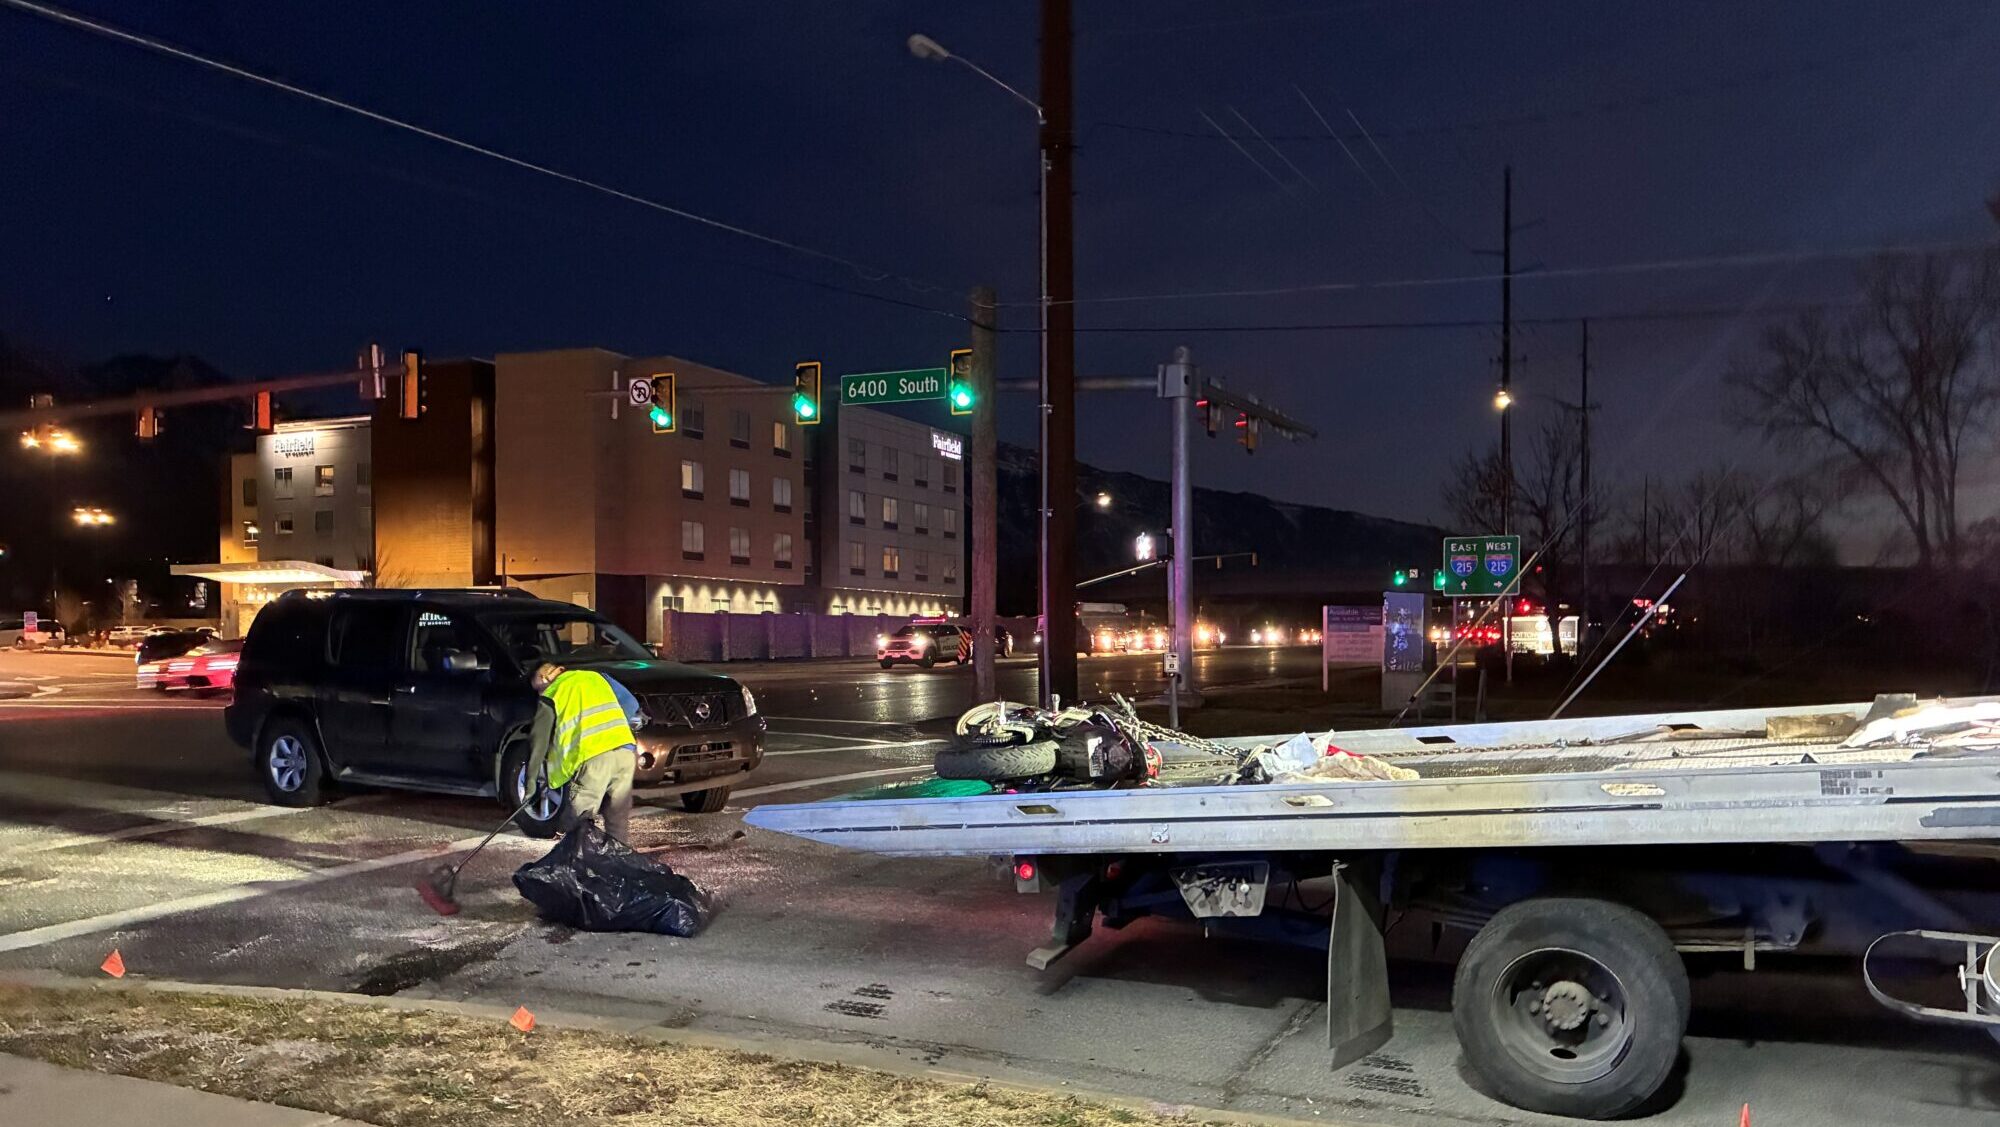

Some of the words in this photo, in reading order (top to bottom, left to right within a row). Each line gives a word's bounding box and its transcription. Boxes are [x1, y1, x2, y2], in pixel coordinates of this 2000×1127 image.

[848, 379, 887, 398] 6400
[898, 376, 938, 394] South
[274, 437, 314, 453] Fairfield
[933, 434, 961, 454] Fairfield
[1450, 543, 1478, 552] EAST
[1486, 541, 1512, 551] WEST
[1456, 562, 1472, 573] 215
[1491, 561, 1507, 572] 215
